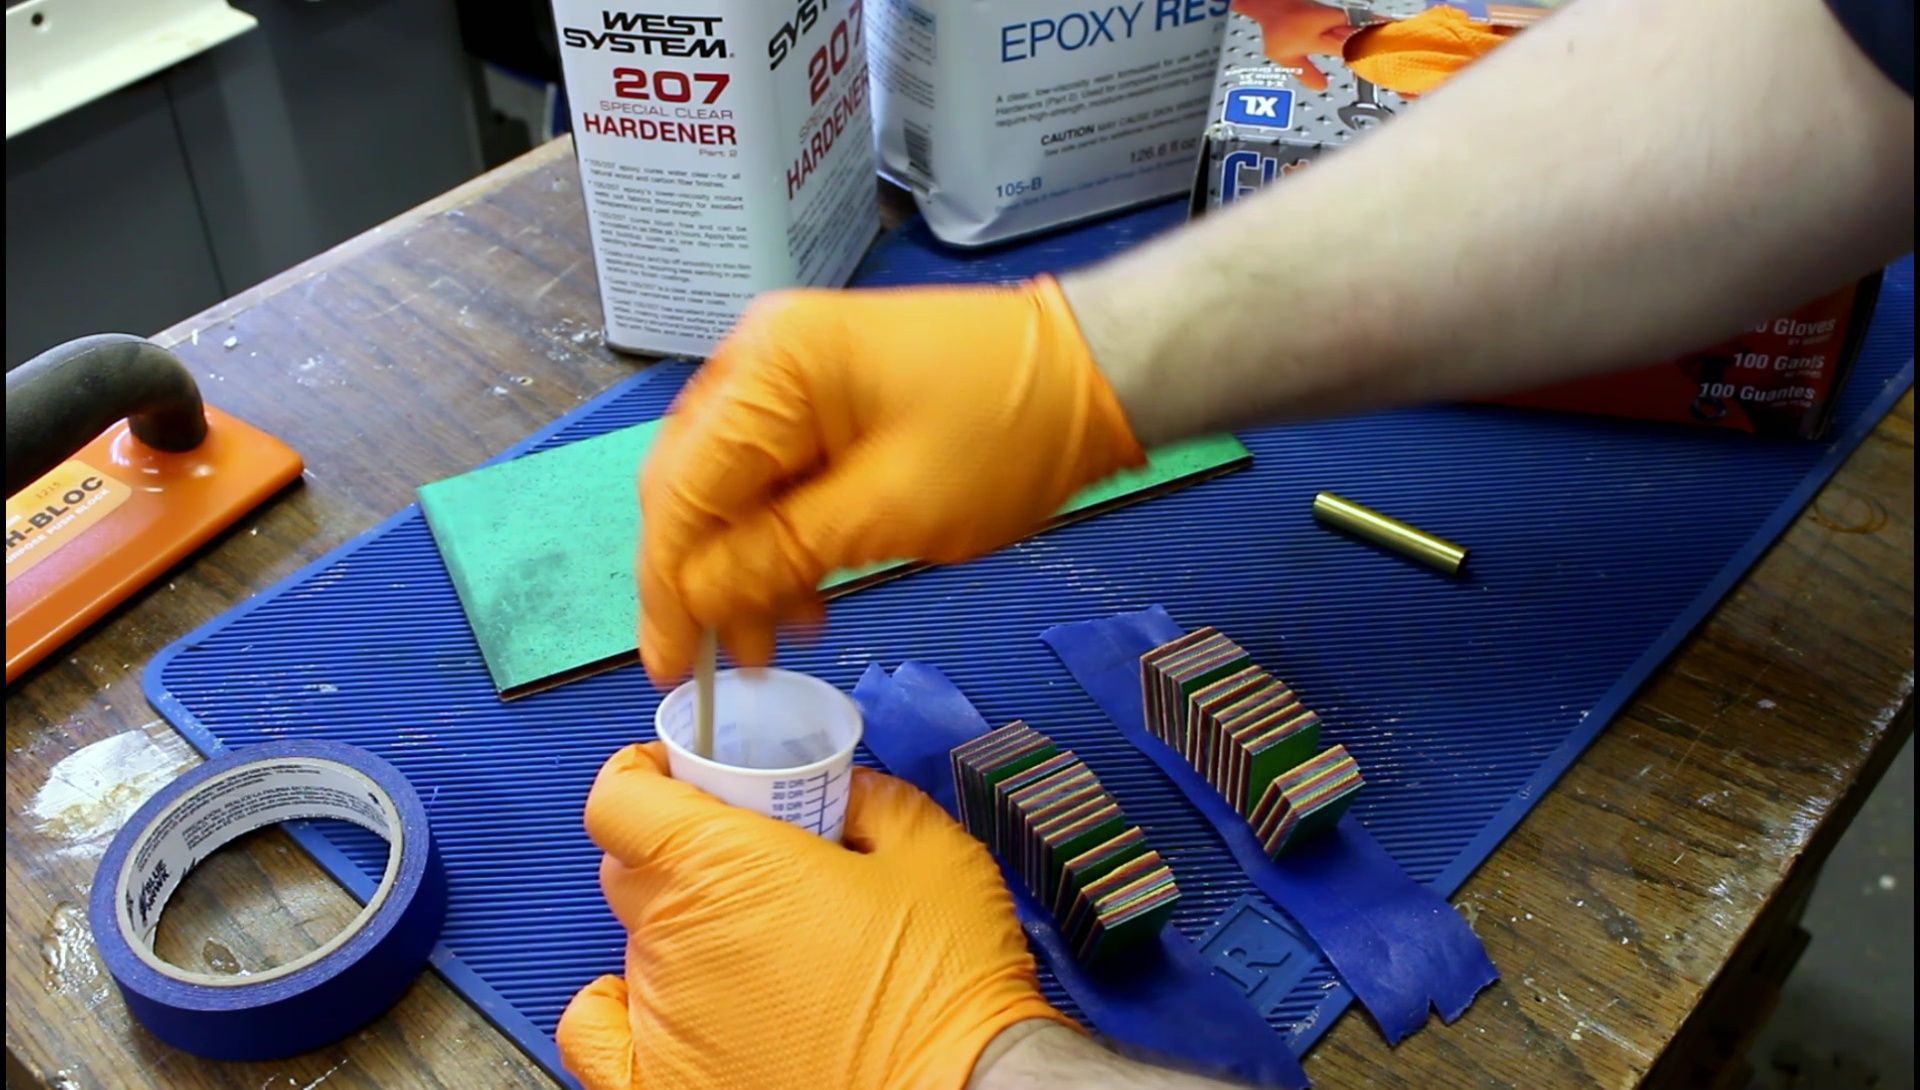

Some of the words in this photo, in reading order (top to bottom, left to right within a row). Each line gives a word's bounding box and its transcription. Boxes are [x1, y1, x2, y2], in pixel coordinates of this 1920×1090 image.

[602, 10, 723, 36] WEST
[1002, 1, 1144, 63] EPOXY
[563, 27, 727, 58] SYSTEM
[808, 0, 864, 106] 207
[612, 67, 730, 104] 207
[600, 100, 669, 116] SPECIAL
[675, 106, 733, 120] CLEAR
[1239, 95, 1278, 118] XL
[583, 112, 737, 146] HARDENER
[786, 62, 869, 201] HARDENER
[1041, 125, 1094, 146] CAUTION
[699, 148, 725, 158] Part
[996, 176, 1042, 198] 105-B
[1774, 318, 1836, 337] Gloves
[1734, 352, 1768, 370] 100
[1699, 382, 1735, 398] 100
